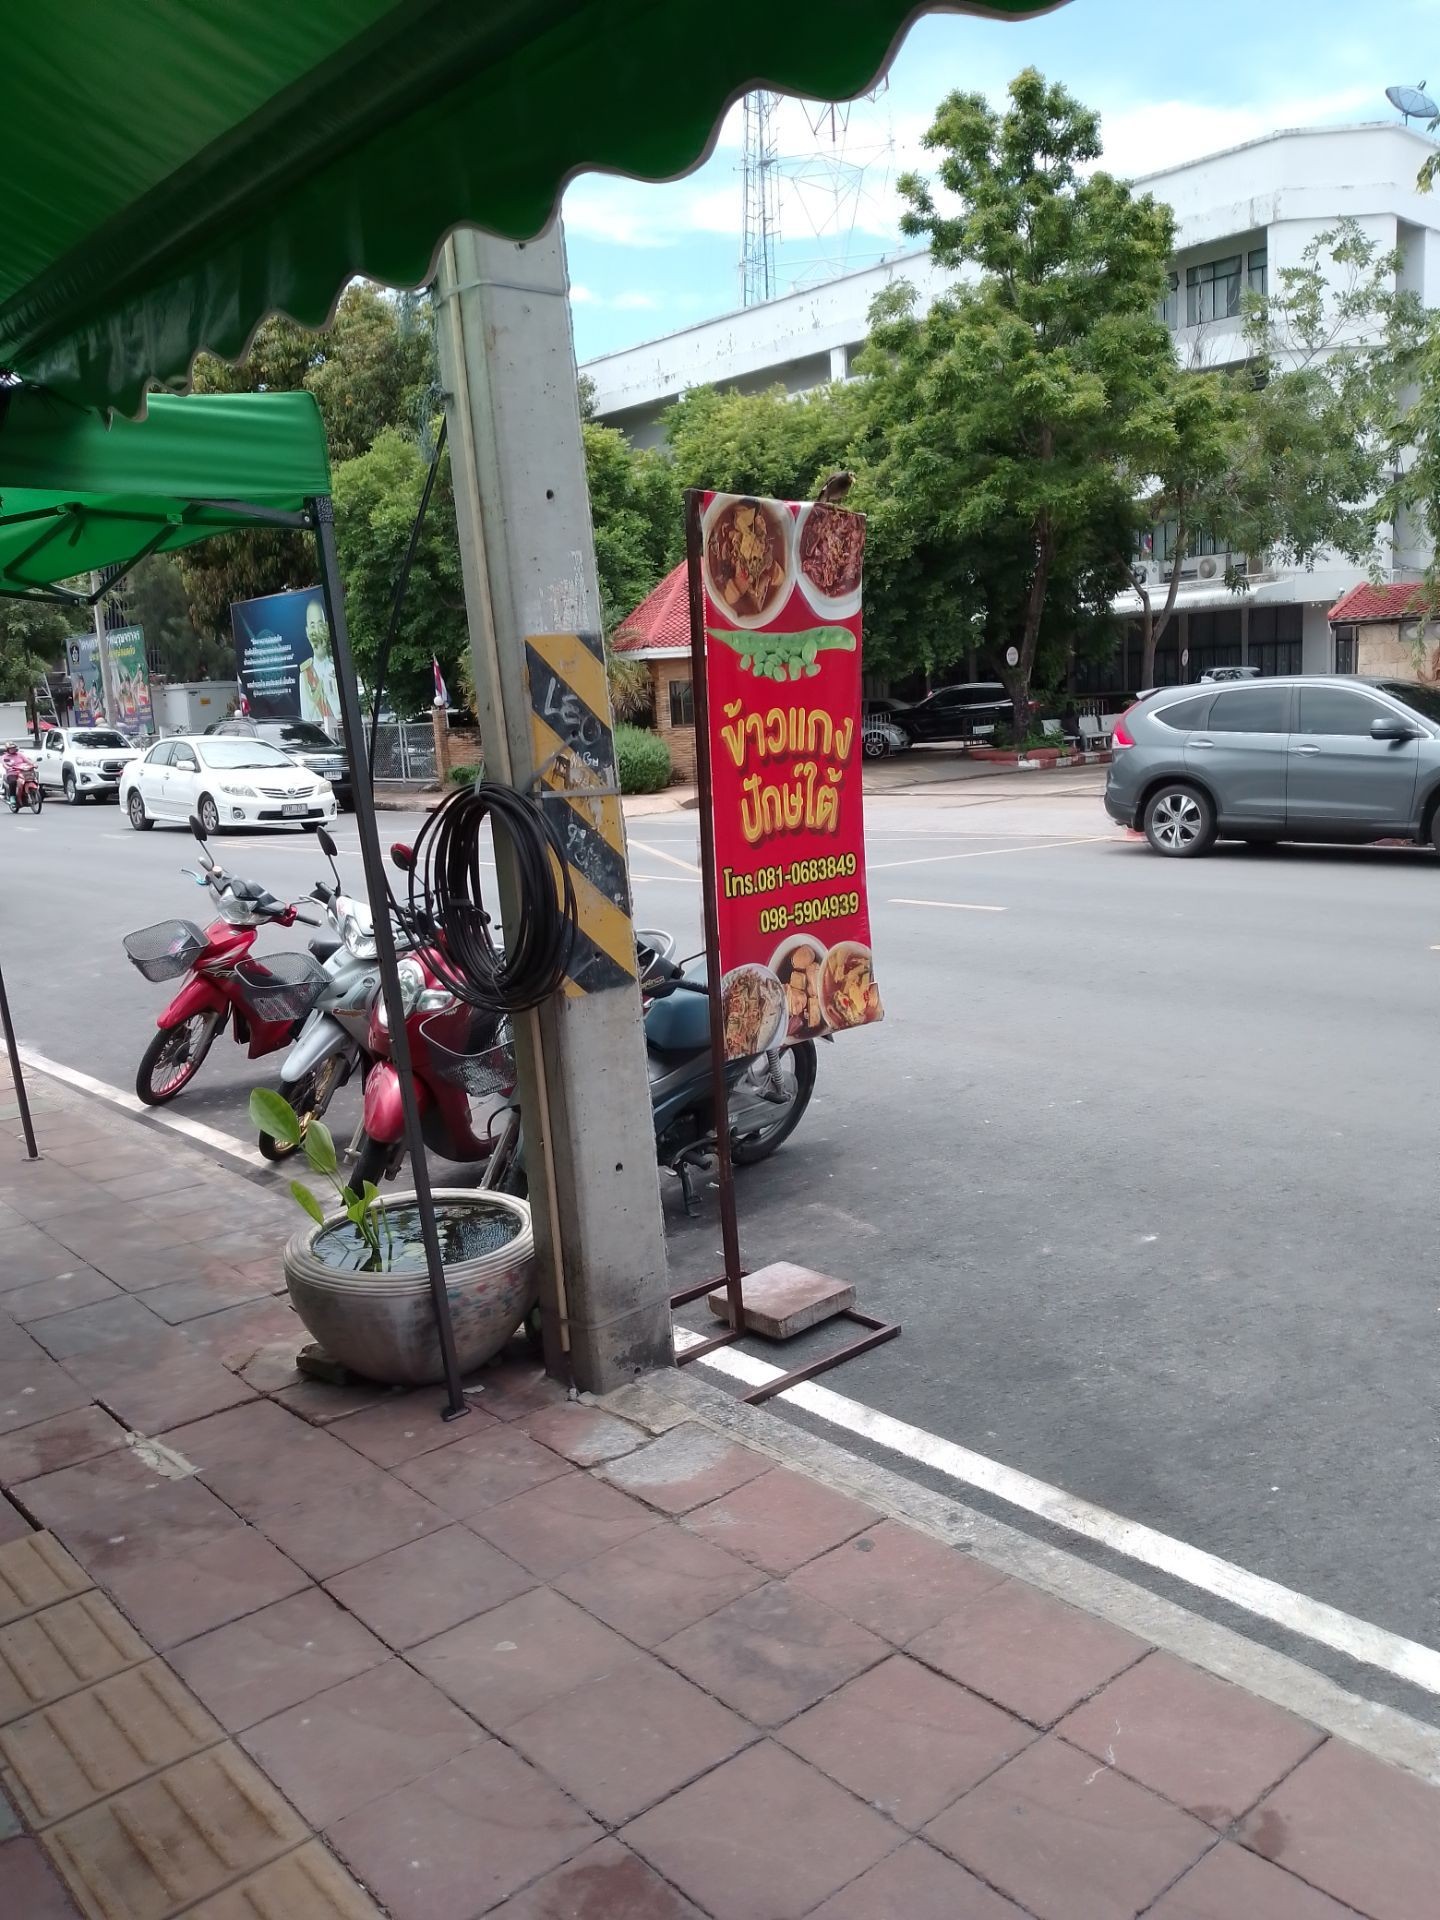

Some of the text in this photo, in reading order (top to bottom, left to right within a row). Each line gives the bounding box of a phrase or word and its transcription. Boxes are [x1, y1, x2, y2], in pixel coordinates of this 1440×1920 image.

[721, 698, 854, 767] ข้าวแกง
[741, 761, 843, 843] ปักษ์ใต้
[759, 891, 860, 934] 098-5904939
